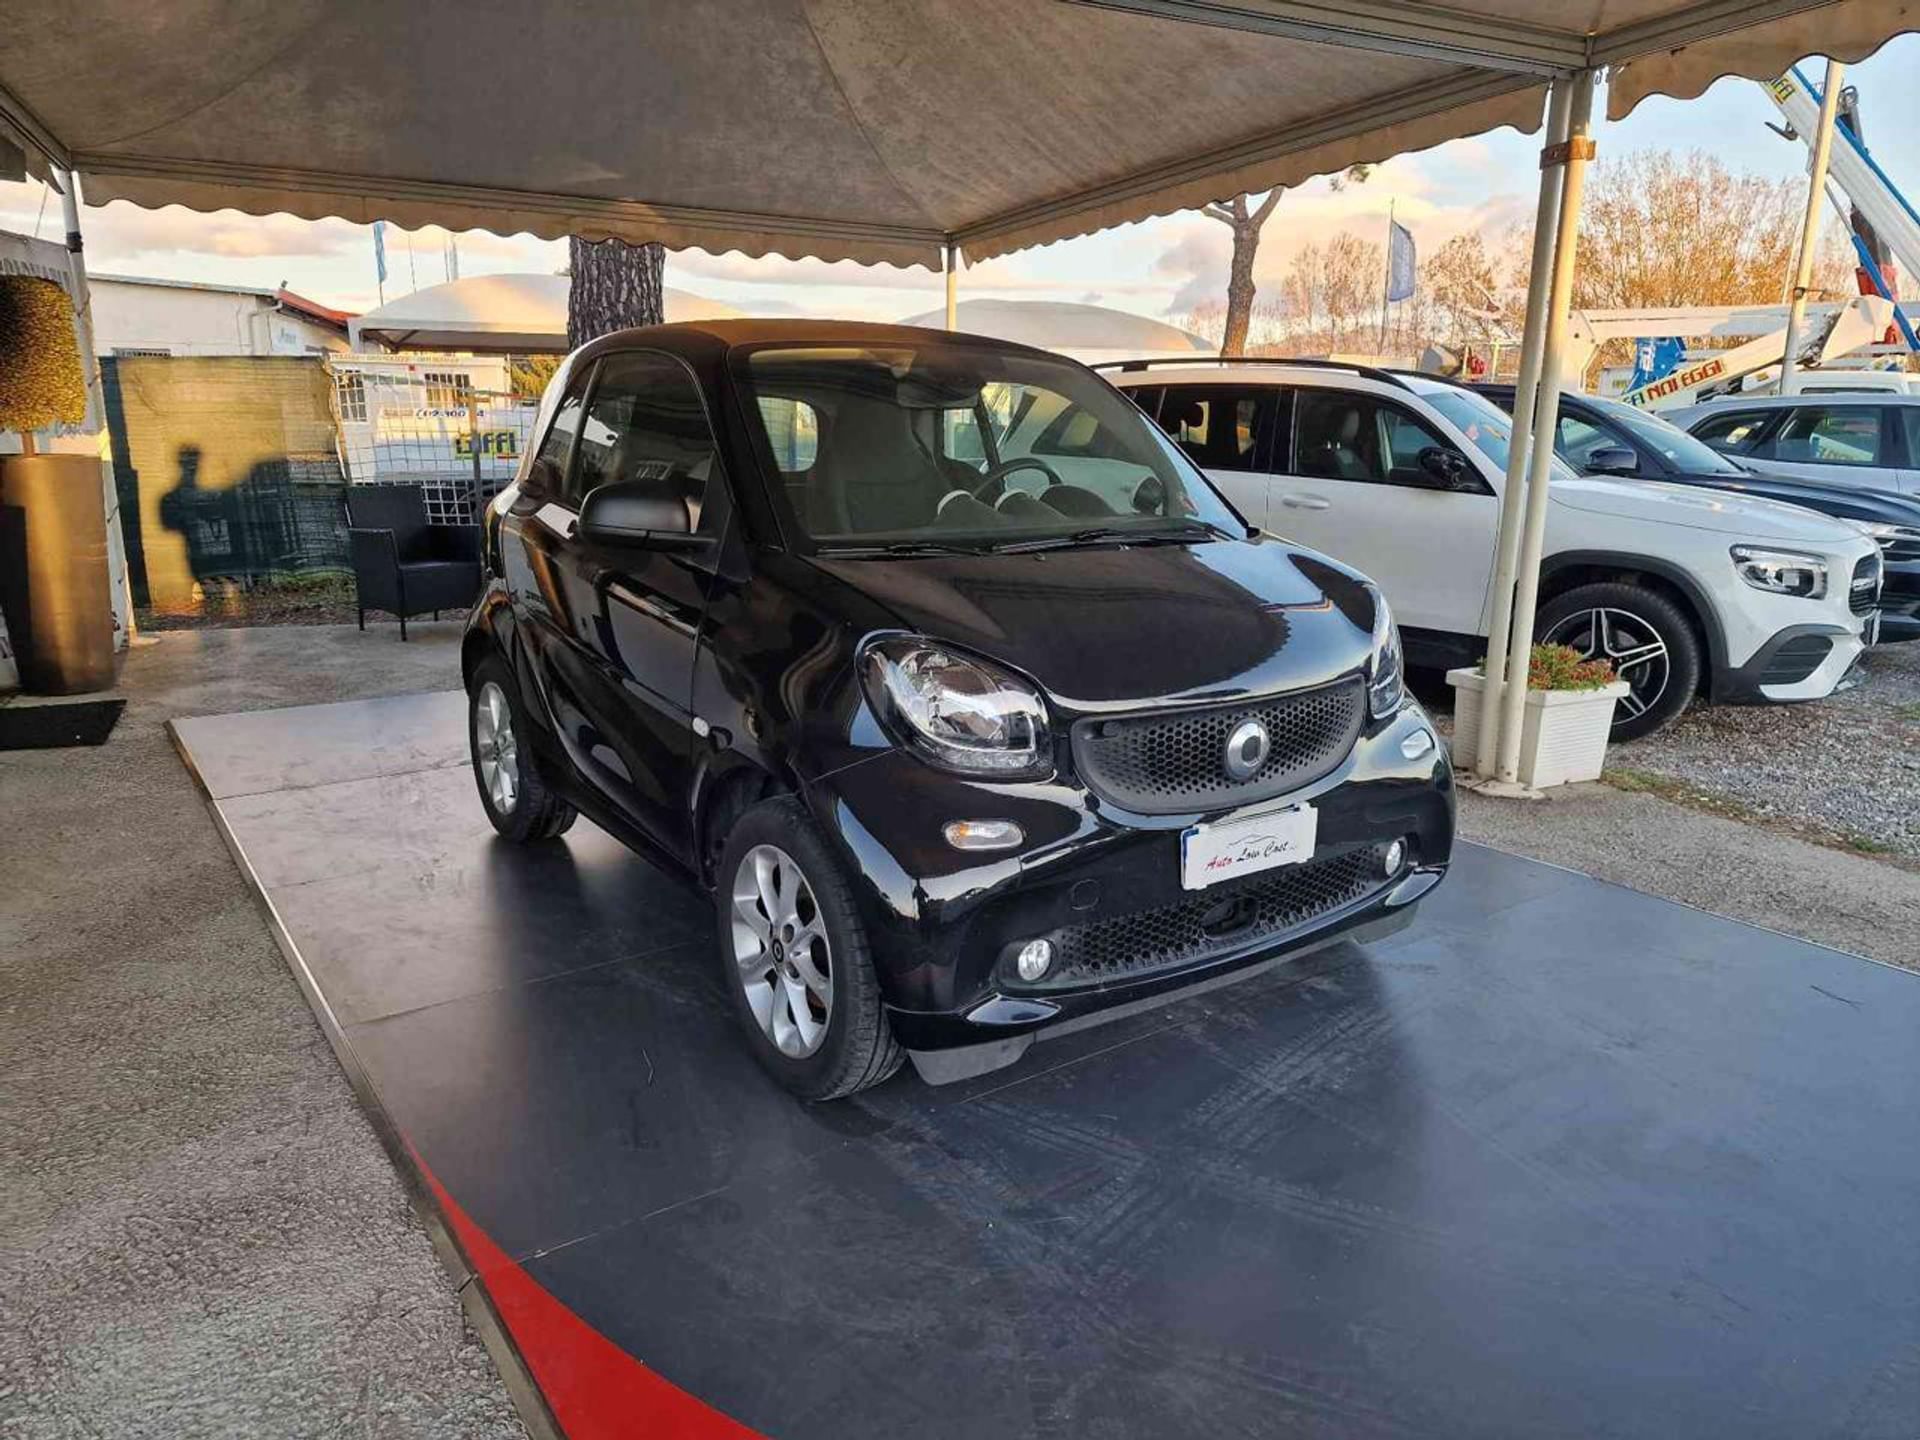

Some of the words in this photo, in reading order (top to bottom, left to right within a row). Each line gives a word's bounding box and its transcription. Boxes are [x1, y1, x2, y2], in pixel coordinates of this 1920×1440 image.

[1205, 855, 1233, 871] Auto
[1236, 847, 1260, 862] Low
[1264, 841, 1289, 858] Cost
